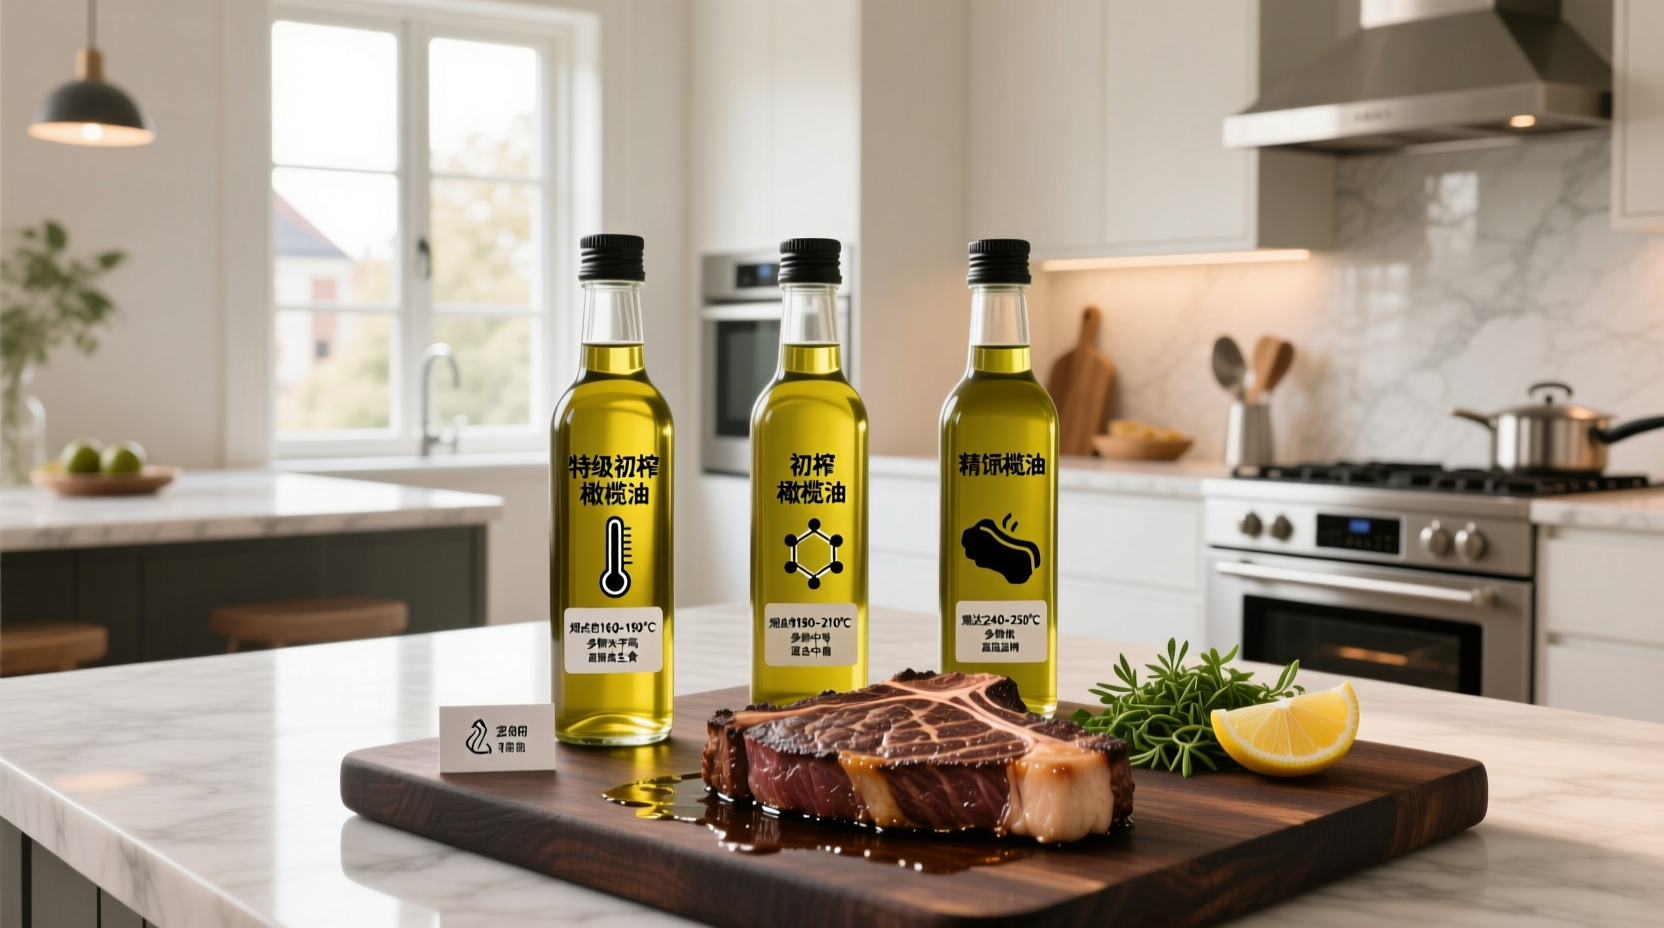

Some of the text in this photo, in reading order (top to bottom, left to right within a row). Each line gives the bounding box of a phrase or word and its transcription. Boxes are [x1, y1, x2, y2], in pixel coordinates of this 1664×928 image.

[569, 454, 659, 478] 特级初榨
[790, 453, 835, 477] 初榨
[580, 481, 649, 506] 橄榄油
[776, 480, 846, 504] 橄榄油
